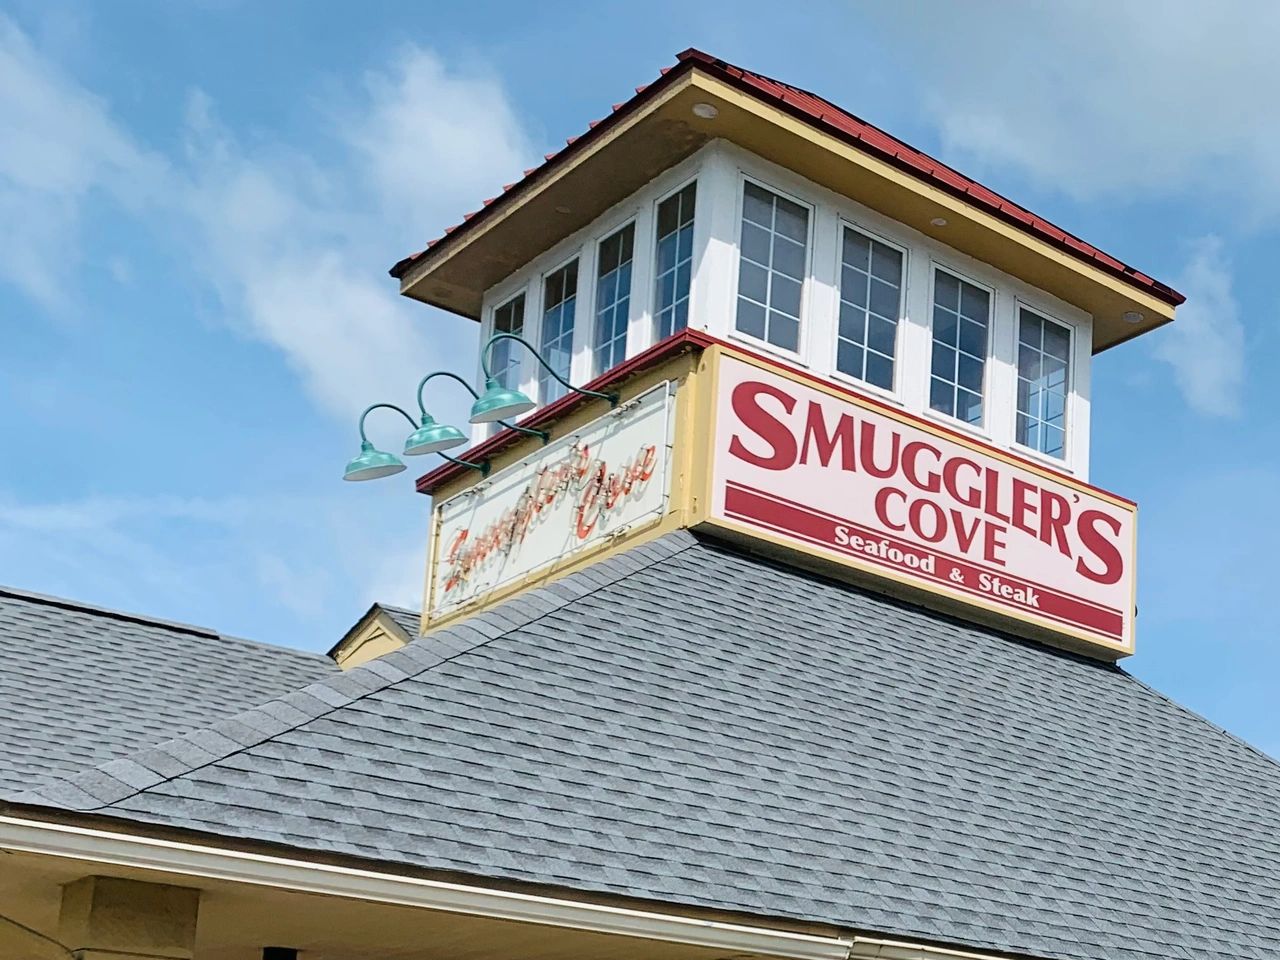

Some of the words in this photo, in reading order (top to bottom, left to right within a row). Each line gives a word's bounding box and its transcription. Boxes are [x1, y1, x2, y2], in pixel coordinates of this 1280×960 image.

[728, 380, 1124, 585] SMUGGLER'S
[834, 525, 936, 575] Seafood
[949, 567, 965, 584] &
[978, 572, 1040, 608] Steak
[874, 486, 1007, 567] COVE
